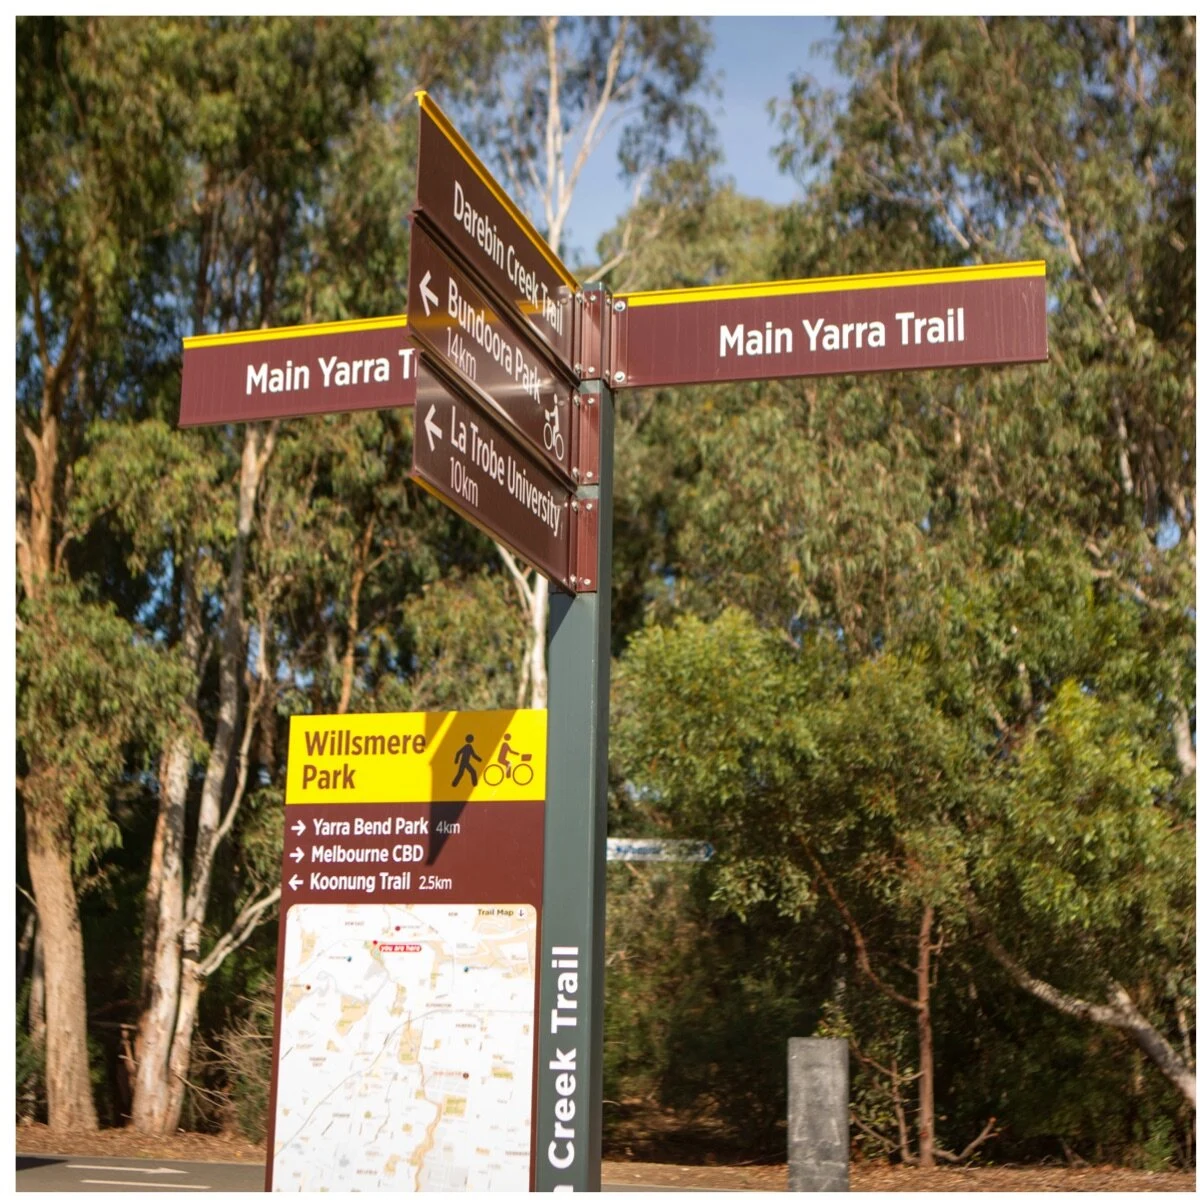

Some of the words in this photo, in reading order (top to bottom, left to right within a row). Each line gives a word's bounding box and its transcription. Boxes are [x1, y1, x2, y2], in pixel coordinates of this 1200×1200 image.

[453, 179, 505, 270] Darebin
[507, 245, 539, 309] Creek
[541, 281, 564, 336] Trail
[447, 326, 477, 381] 14km
[448, 276, 513, 375] Bundoora
[515, 346, 541, 404] Park
[719, 321, 793, 357] Main
[802, 318, 886, 352] Yarra
[895, 307, 965, 345] Trail
[246, 360, 310, 395] Main
[318, 356, 390, 388] Yarra
[450, 405, 467, 454] La
[470, 421, 505, 486] Trobe
[507, 455, 561, 537] University
[450, 456, 479, 508] 10km
[304, 730, 427, 756] Willsmere
[302, 763, 356, 790] Park
[313, 818, 350, 836] Yarra
[354, 817, 392, 835] Bend
[395, 817, 429, 835] Park
[436, 820, 461, 834] 4km
[311, 845, 389, 863] Melbourne
[392, 844, 424, 862] CBD
[310, 872, 376, 893] Koonung
[379, 871, 411, 890] Trail
[418, 876, 452, 890] 2.5km
[497, 908, 514, 917] Map
[550, 946, 579, 1034] Trail
[547, 1047, 577, 1169] Creek
